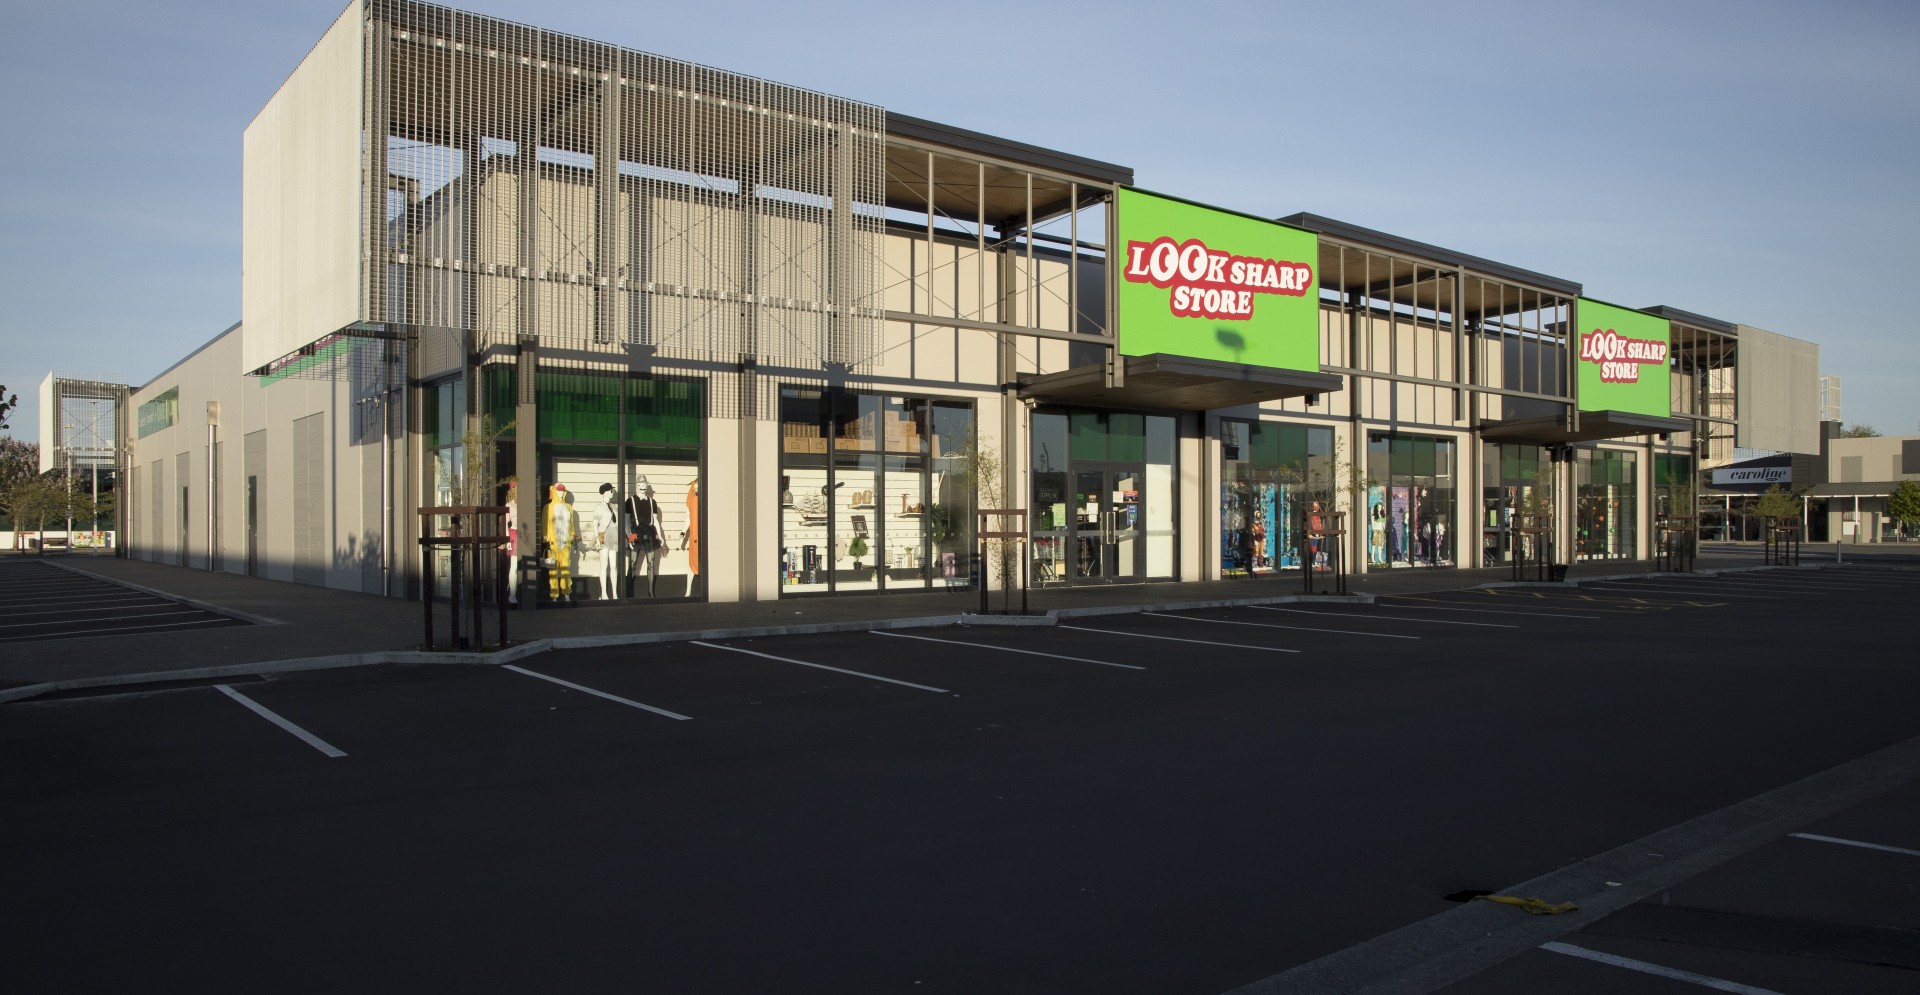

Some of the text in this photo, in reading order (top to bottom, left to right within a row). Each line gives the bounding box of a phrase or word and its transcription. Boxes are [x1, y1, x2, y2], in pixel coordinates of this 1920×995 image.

[1129, 242, 1309, 290] LOOK SHARP
[1173, 285, 1252, 314] STORE
[1582, 333, 1666, 360] LOOK SHARP
[1602, 362, 1638, 379] STORE
[1730, 468, 1786, 479] caroline
